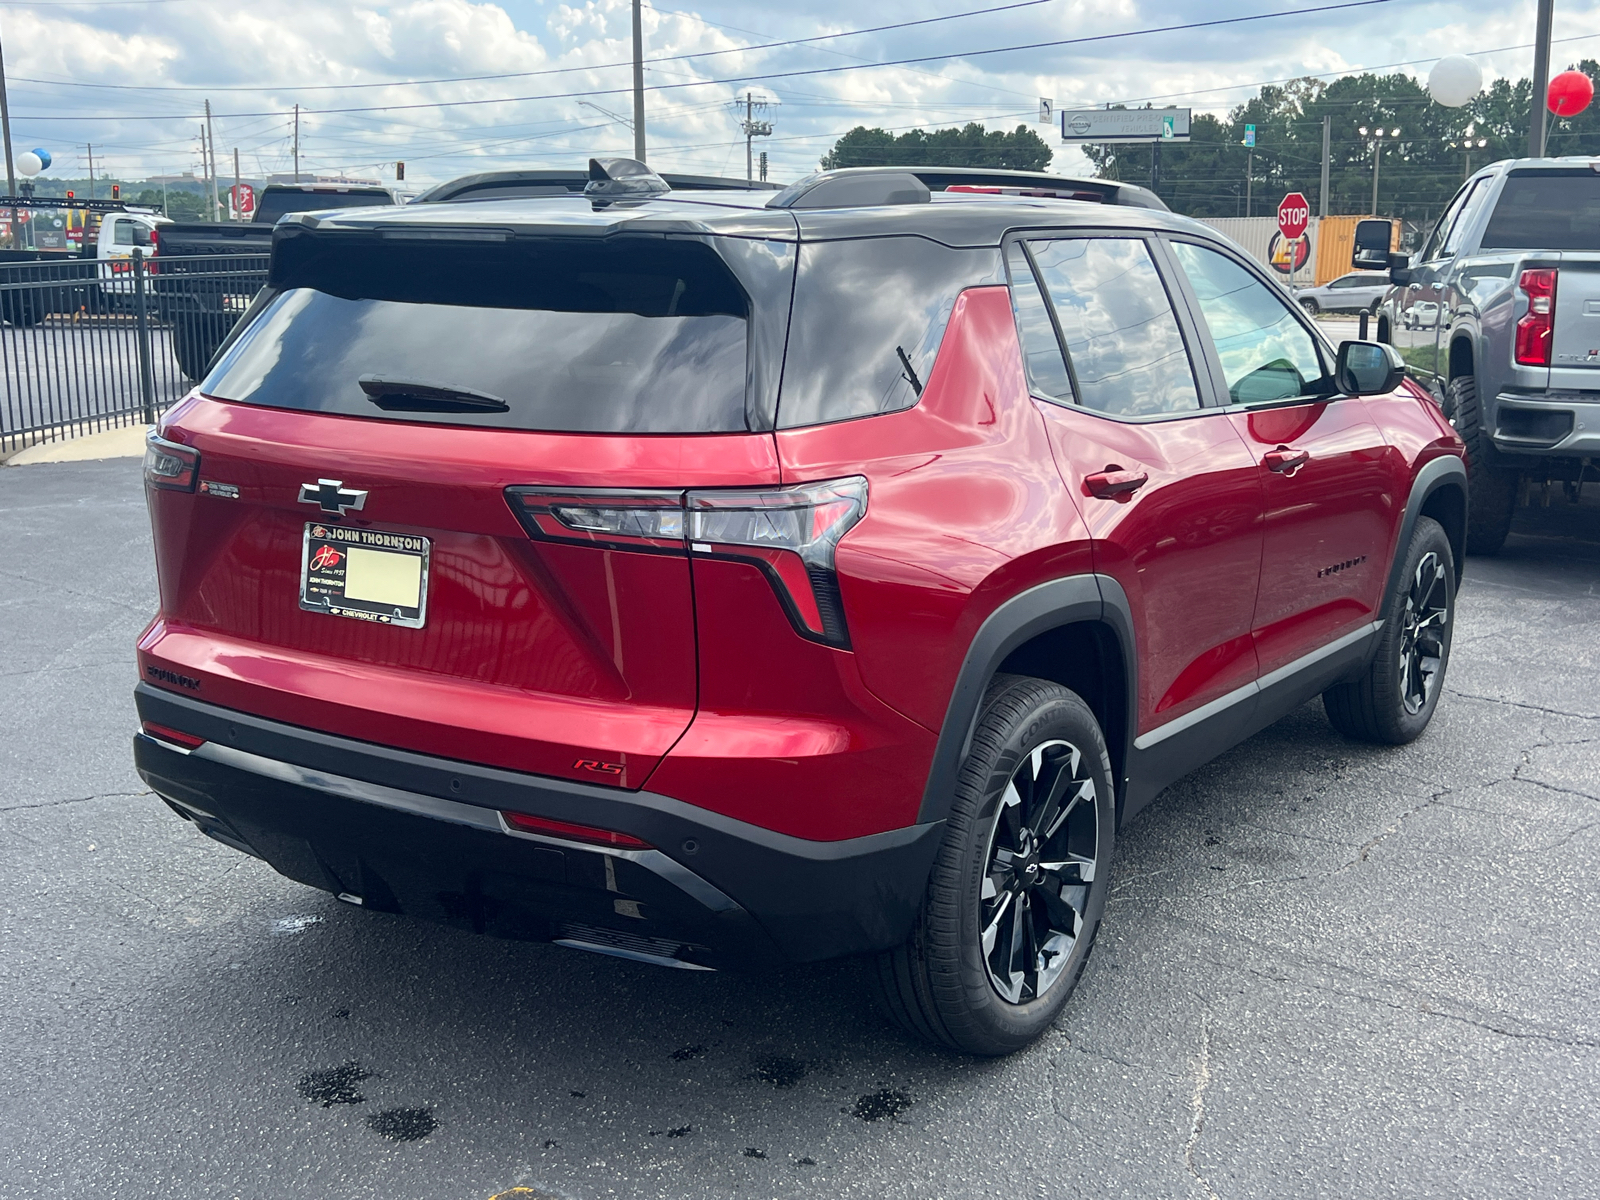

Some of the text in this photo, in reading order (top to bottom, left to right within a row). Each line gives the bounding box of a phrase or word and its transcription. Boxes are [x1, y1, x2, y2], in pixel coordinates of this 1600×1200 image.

[1092, 114, 1134, 123] CERTIFIED
[1120, 124, 1159, 133] VEHICLES
[1279, 207, 1307, 226] STOP
[331, 528, 421, 551] JOHN THORNTON
[342, 609, 378, 621] CHEVROLET
[147, 664, 201, 691] EQUINOX
[572, 758, 626, 775] RS
